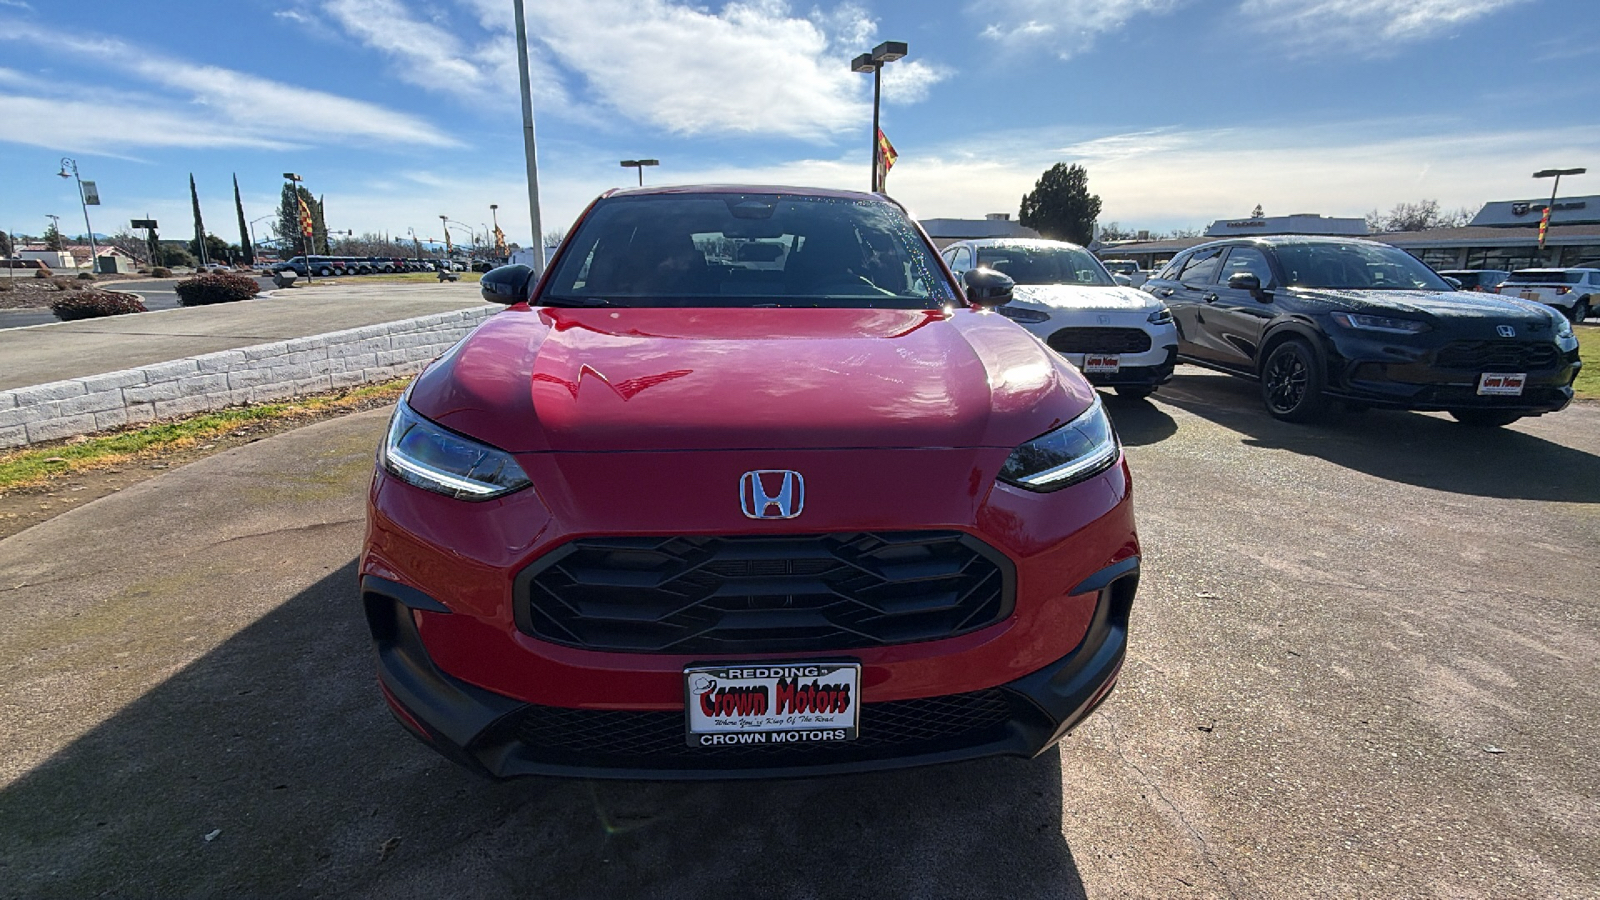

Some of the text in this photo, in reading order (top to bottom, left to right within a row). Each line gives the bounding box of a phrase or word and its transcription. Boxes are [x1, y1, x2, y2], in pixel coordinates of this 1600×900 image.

[728, 667, 819, 679] REDDING
[700, 678, 851, 718] Crown Motors
[765, 717, 784, 725] King
[786, 716, 797, 724] Of
[700, 729, 846, 746] CROWN MOTORS
